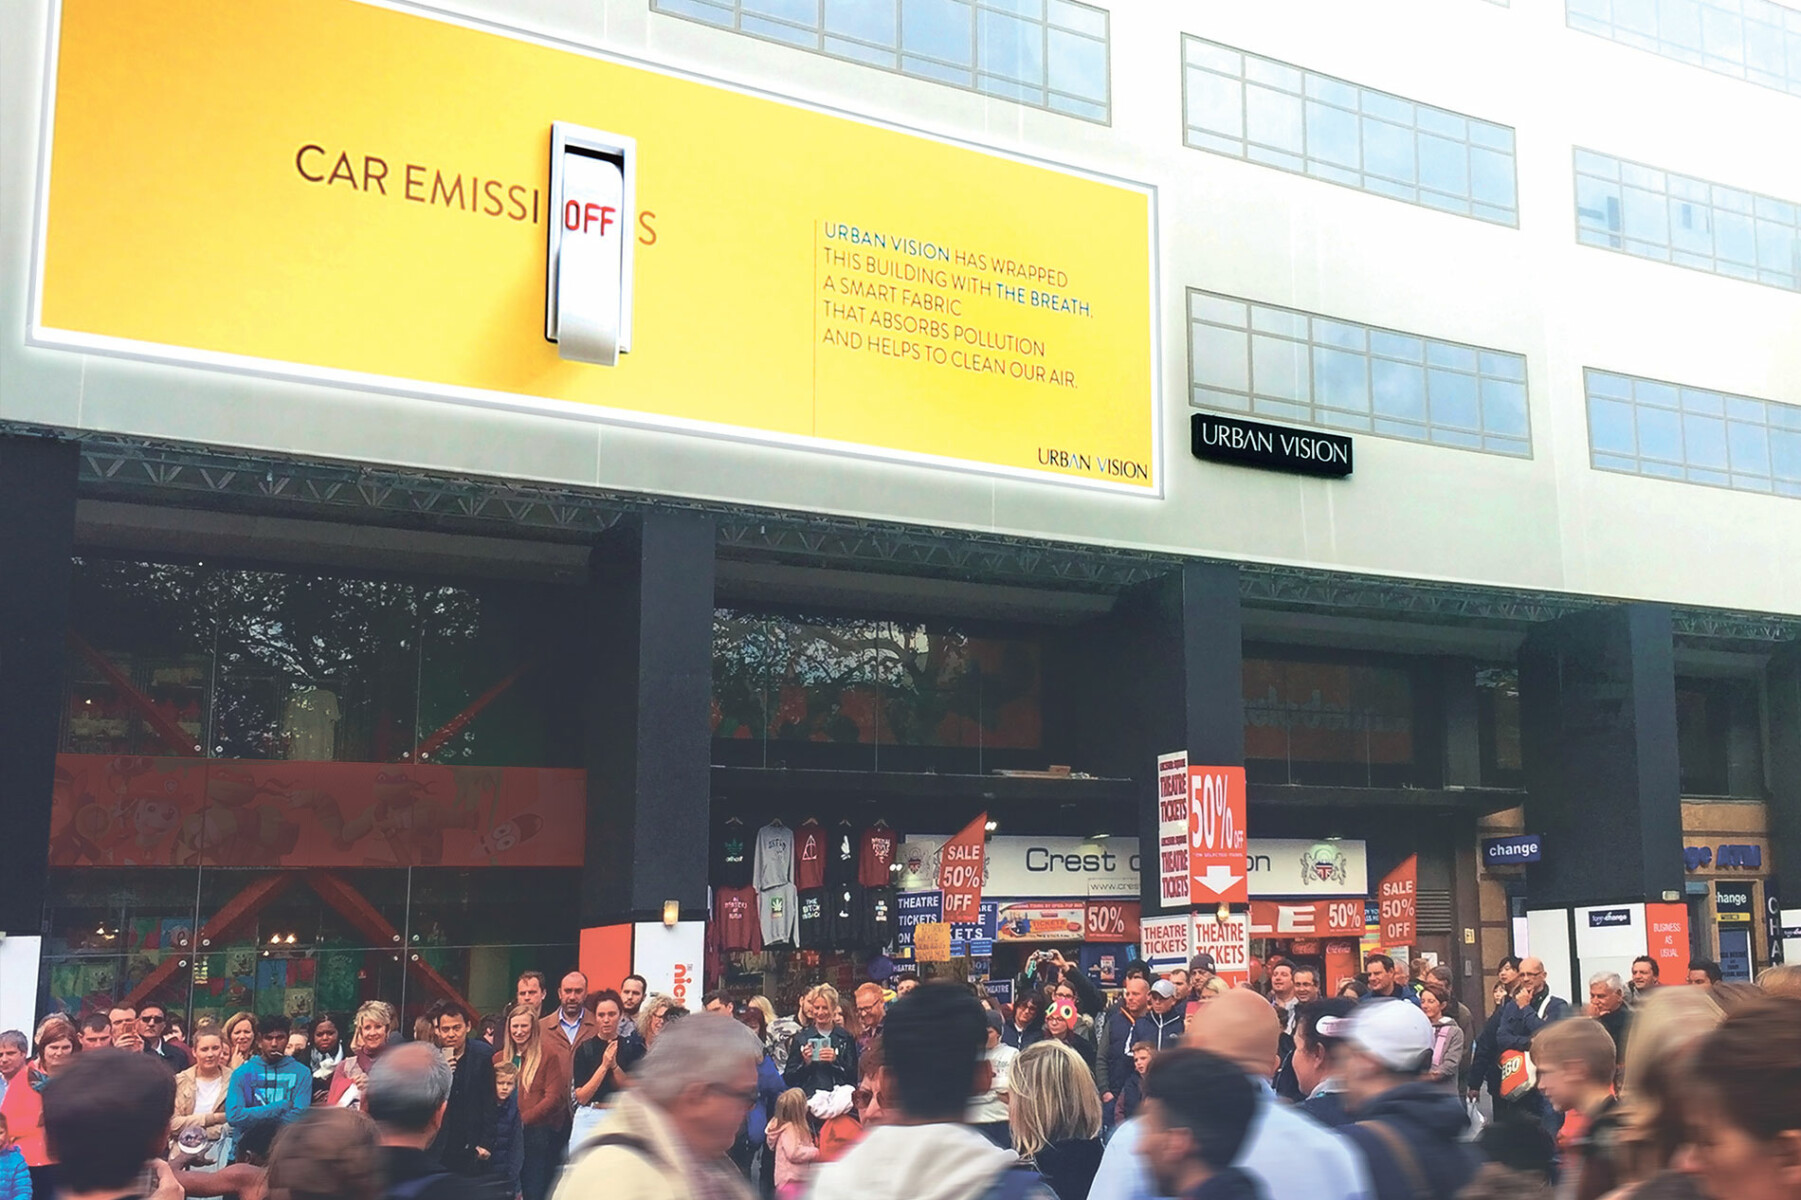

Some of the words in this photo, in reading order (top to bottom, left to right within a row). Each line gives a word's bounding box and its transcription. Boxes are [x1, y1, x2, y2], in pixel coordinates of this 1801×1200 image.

[295, 143, 388, 196] CAR
[564, 199, 616, 237] OFF
[824, 221, 886, 249] URBAN
[890, 235, 950, 262] VISION
[955, 249, 987, 271] HAS
[991, 258, 1068, 288] WRAPPED
[824, 247, 862, 270] THIS
[866, 255, 948, 288] BUILDING
[951, 274, 991, 296] WITH
[996, 283, 1025, 305] THE
[1031, 290, 1094, 318] BREATH.
[823, 275, 836, 292] A
[840, 279, 898, 305] SMART
[902, 289, 962, 317] FABRIC
[823, 300, 866, 324] THAT
[870, 309, 950, 340] ABSORBS
[954, 325, 1045, 357] POLLUTION
[823, 328, 863, 350] AND
[868, 336, 921, 362] HELPS
[924, 345, 948, 365] TO
[951, 351, 1006, 376] CLEAN
[1009, 361, 1046, 383] OUR
[1049, 369, 1078, 389] AIR.
[1202, 422, 1273, 454] URBAN
[1280, 434, 1348, 465] VISION
[1038, 447, 1092, 471] URBAN
[1097, 456, 1148, 481] VISION
[1160, 773, 1187, 798] THEATRE
[1160, 798, 1187, 823] TICKETS
[1191, 774, 1234, 850] 50%
[1234, 830, 1243, 849] OFF
[1489, 842, 1538, 857] change
[947, 845, 980, 860] SALE
[1026, 847, 1116, 872] Crest
[1161, 849, 1188, 873] THEATRE
[943, 865, 979, 888] 50%
[1162, 875, 1189, 899] TICKETS
[1383, 880, 1414, 896] SALE
[898, 896, 939, 908] THEATRE
[945, 894, 972, 911] OFF
[1382, 898, 1415, 918] 50%
[1716, 891, 1746, 905] hange
[898, 914, 938, 926] TICKETS
[1088, 906, 1125, 932] 50%
[1329, 903, 1361, 928] 50%
[1653, 922, 1681, 932] BUSINESS
[898, 933, 911, 944] ON
[1144, 924, 1187, 939] THEATRE
[1195, 922, 1244, 942] THEATRE
[1387, 922, 1411, 938] OFF
[1665, 935, 1673, 944] AS
[1144, 938, 1188, 954] TICKETS
[1660, 948, 1679, 957] USUAL
